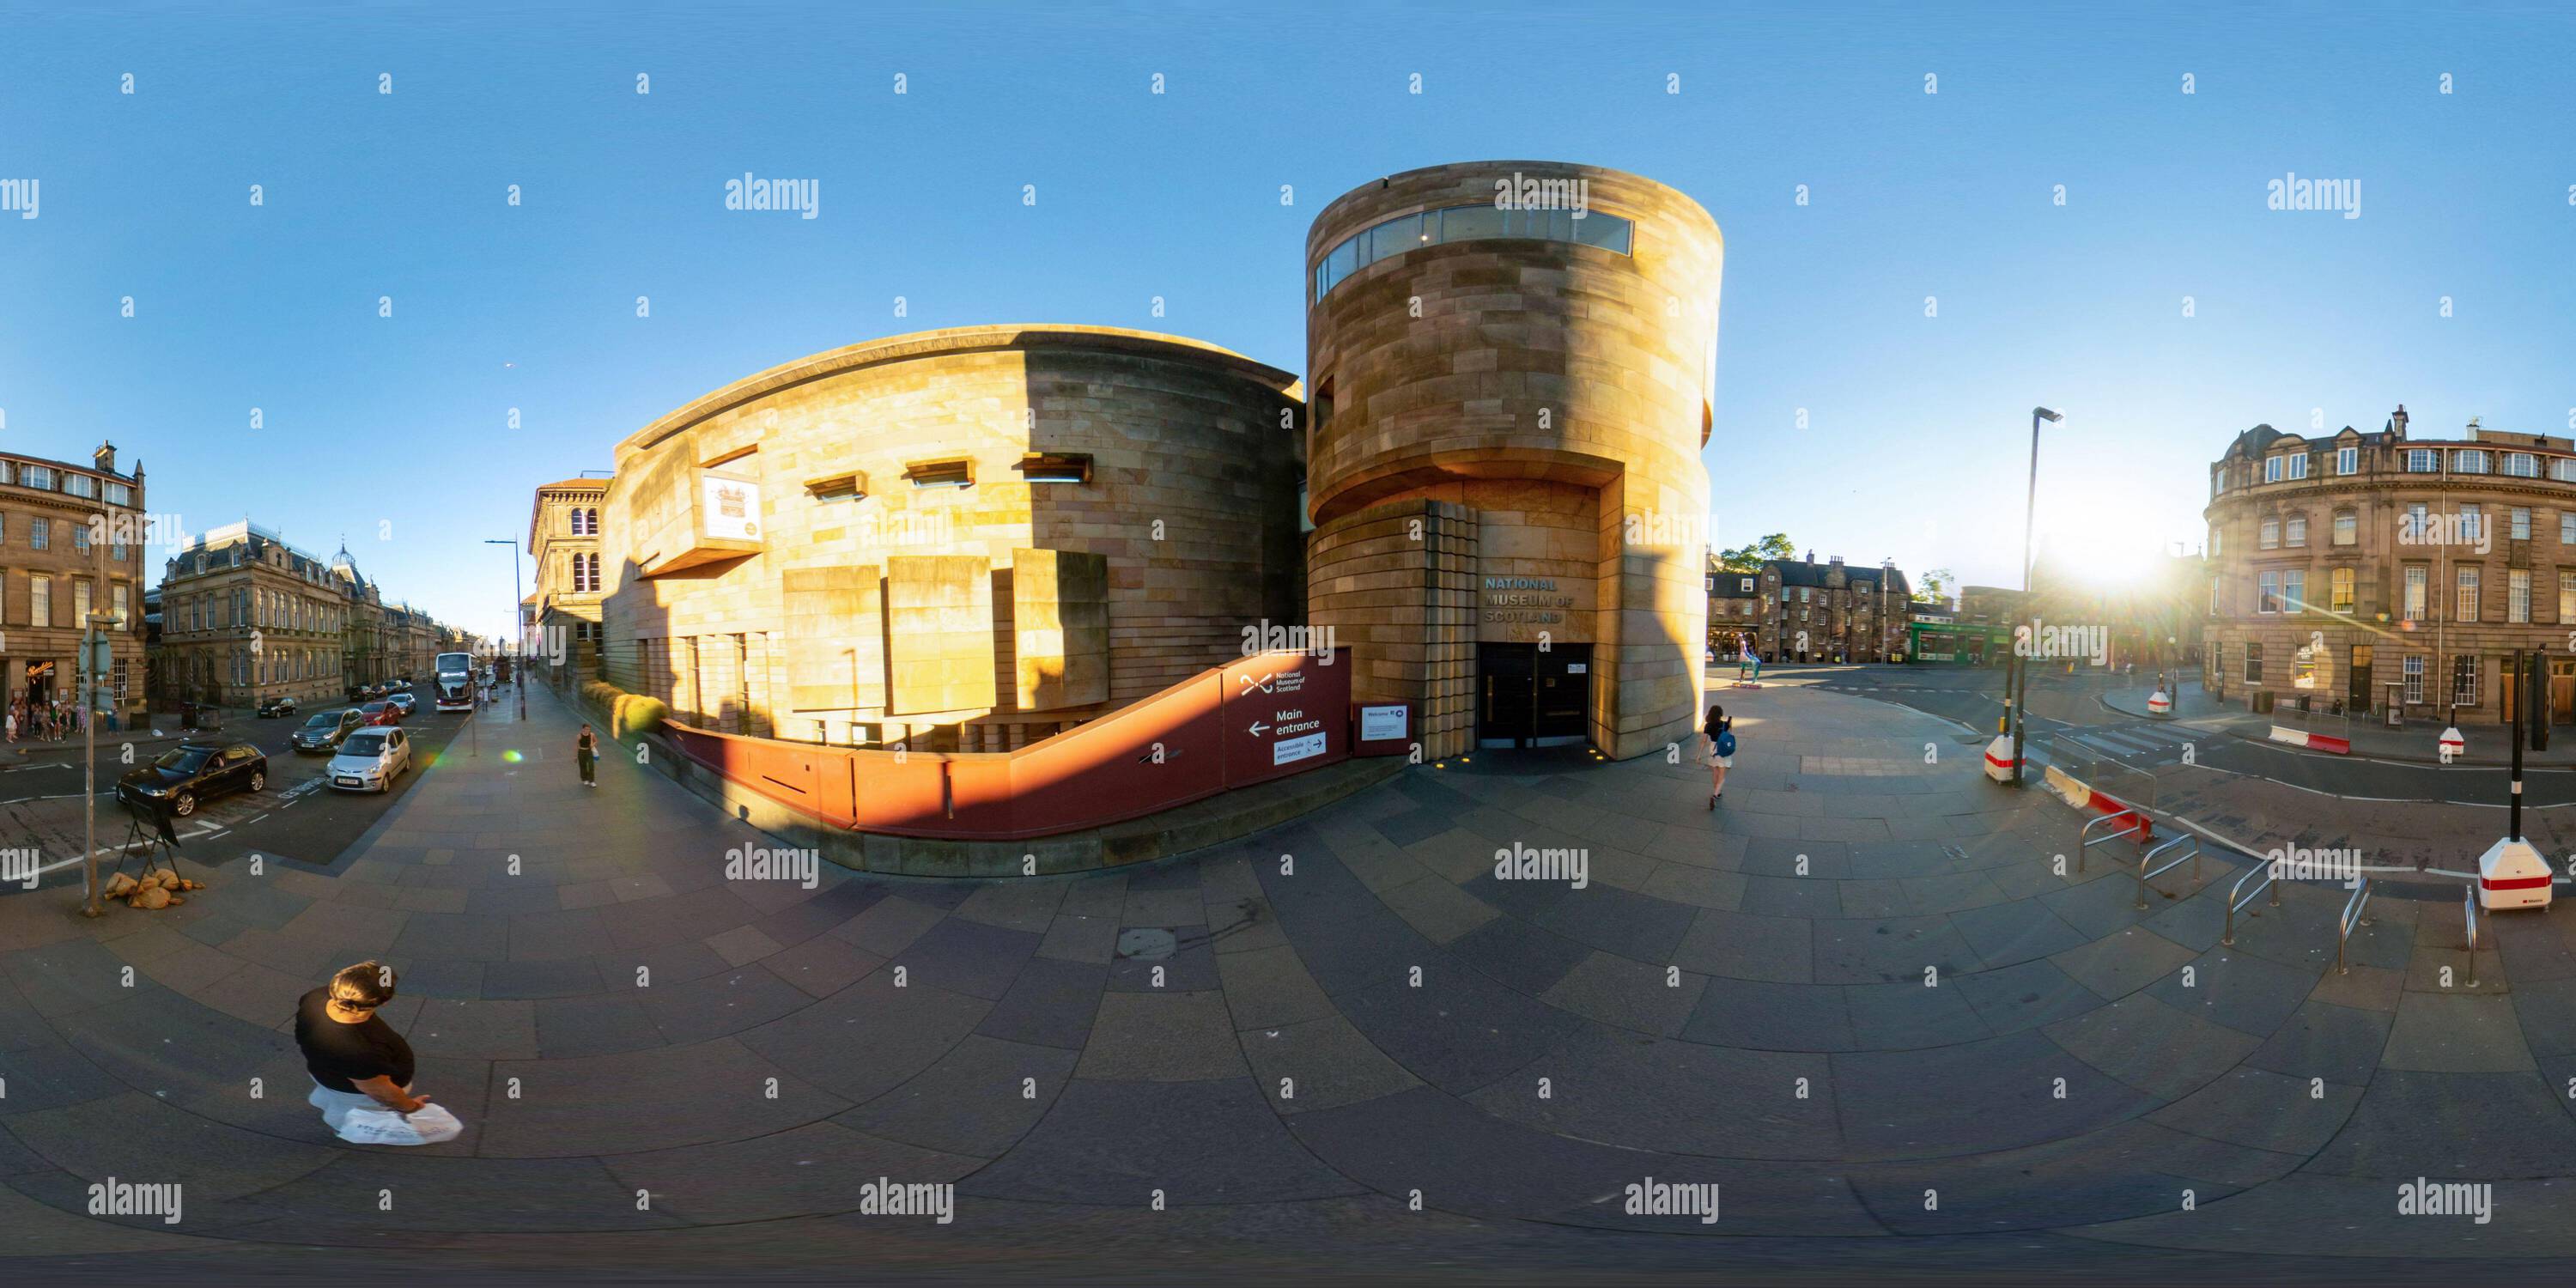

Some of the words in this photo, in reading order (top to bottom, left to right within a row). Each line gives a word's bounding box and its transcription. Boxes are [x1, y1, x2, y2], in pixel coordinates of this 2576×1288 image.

[1485, 577, 1558, 591] NATIONAL
[1485, 594, 1552, 606] MUSEUM
[1556, 597, 1573, 608] OF
[1485, 611, 1562, 623] SCOTLAND
[1276, 684, 1301, 693] Scotland
[1276, 709, 1303, 722] Main
[1276, 720, 1320, 735] entrance
[1277, 742, 1304, 752] Accessible
[1277, 750, 1301, 760] entrance
